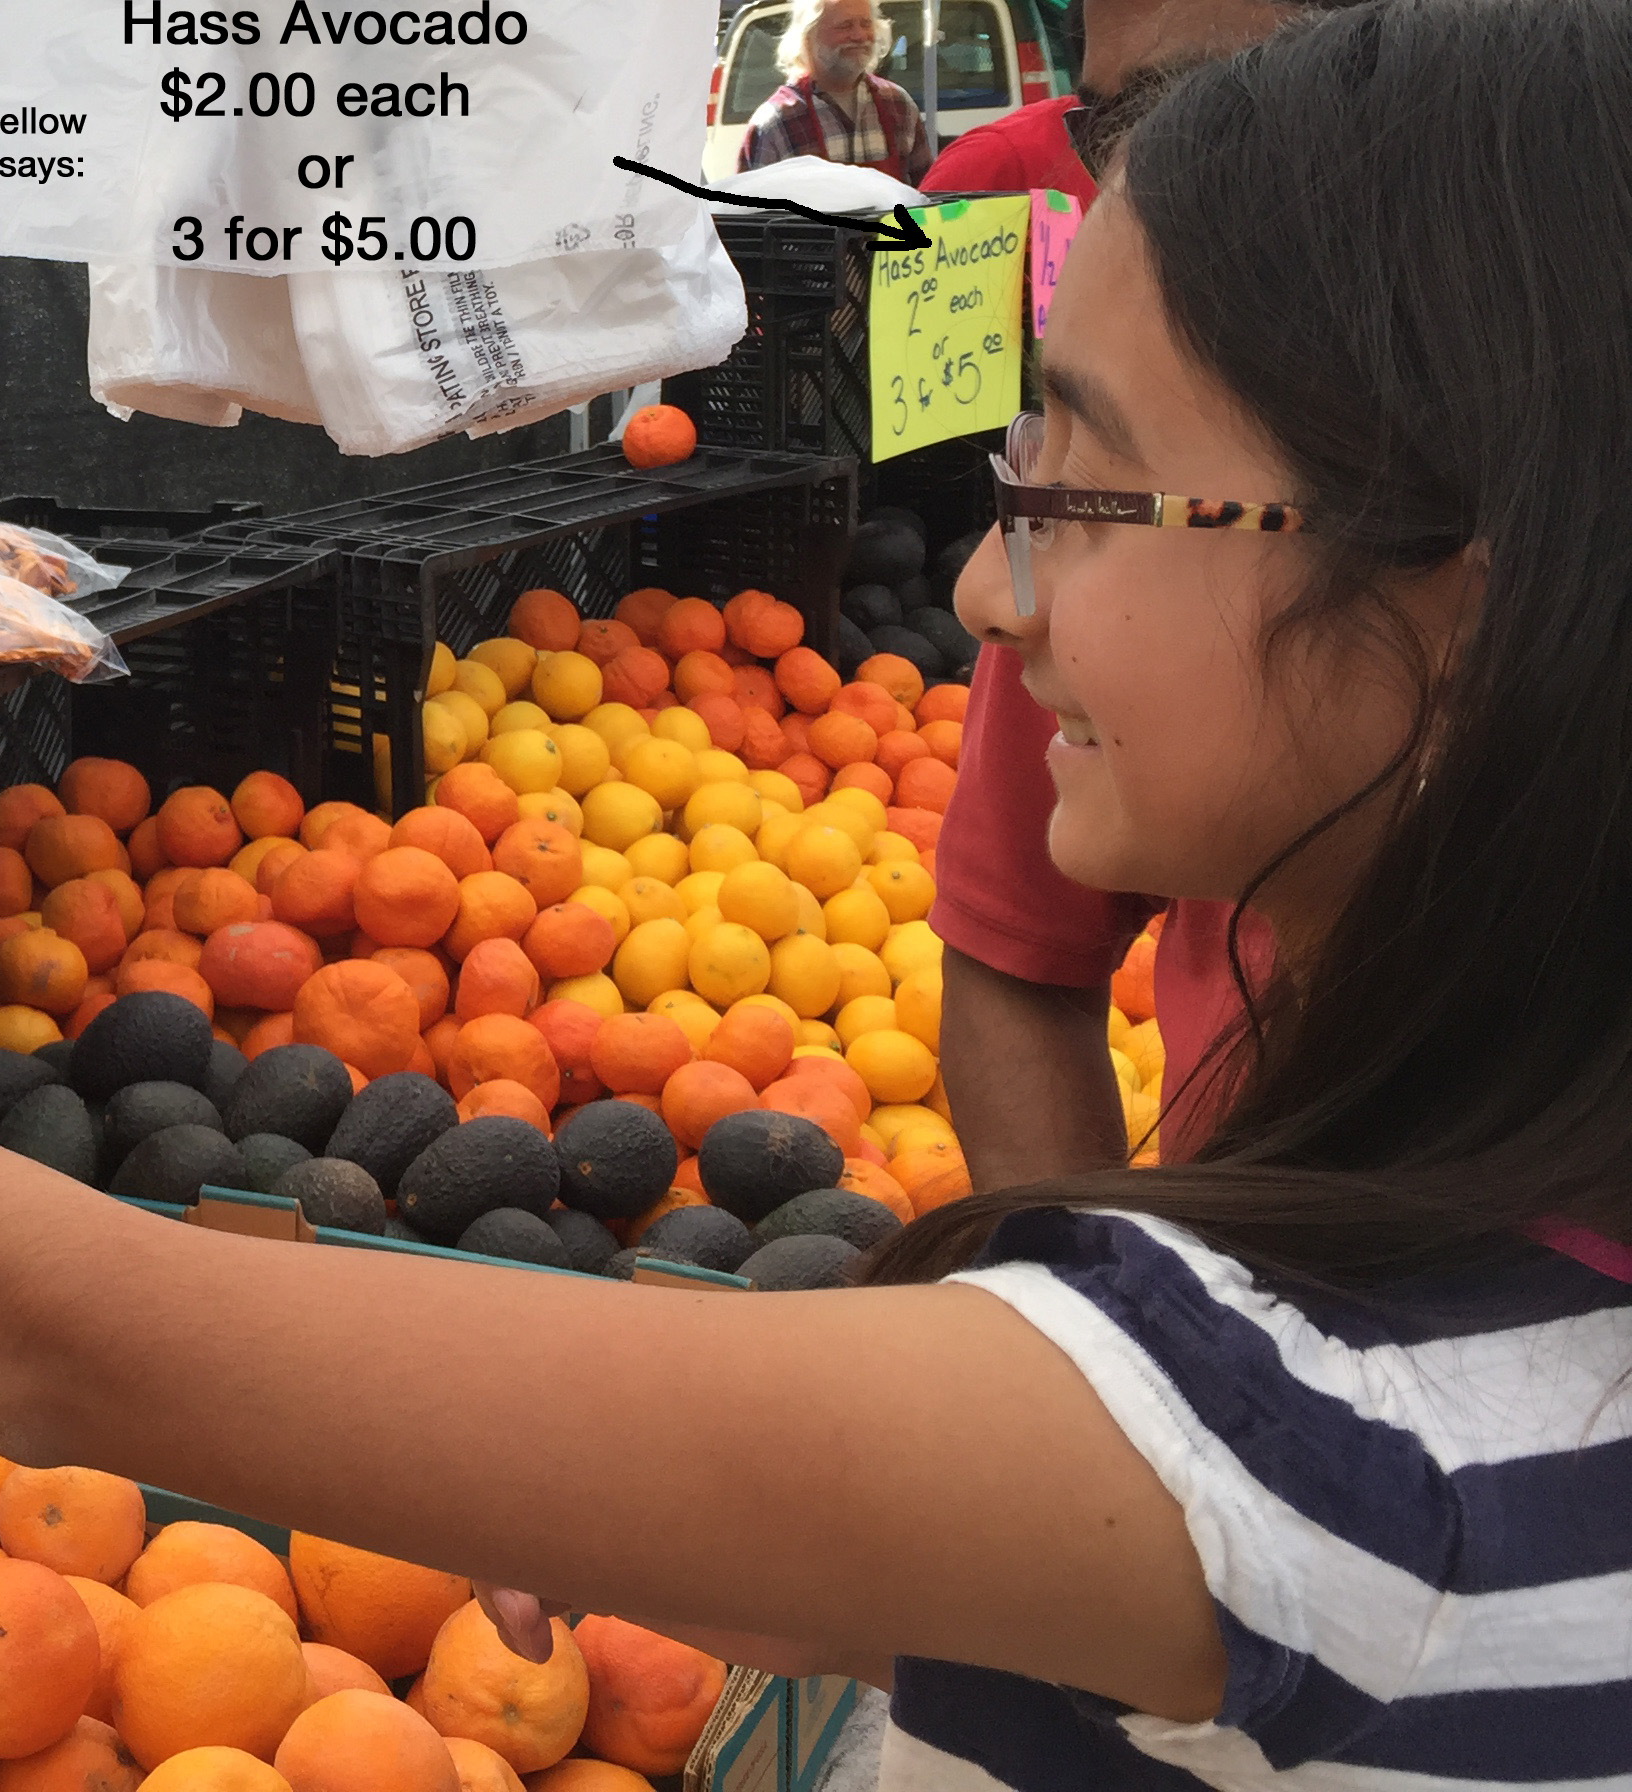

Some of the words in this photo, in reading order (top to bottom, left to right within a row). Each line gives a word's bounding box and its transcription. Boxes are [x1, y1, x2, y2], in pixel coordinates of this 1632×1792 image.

[878, 248, 925, 288] Hass
[934, 225, 1019, 272] Avocado
[405, 279, 442, 352] STORE
[455, 296, 472, 326] THIN
[949, 285, 984, 314] each
[932, 336, 949, 361] or
[890, 375, 909, 436] 3
